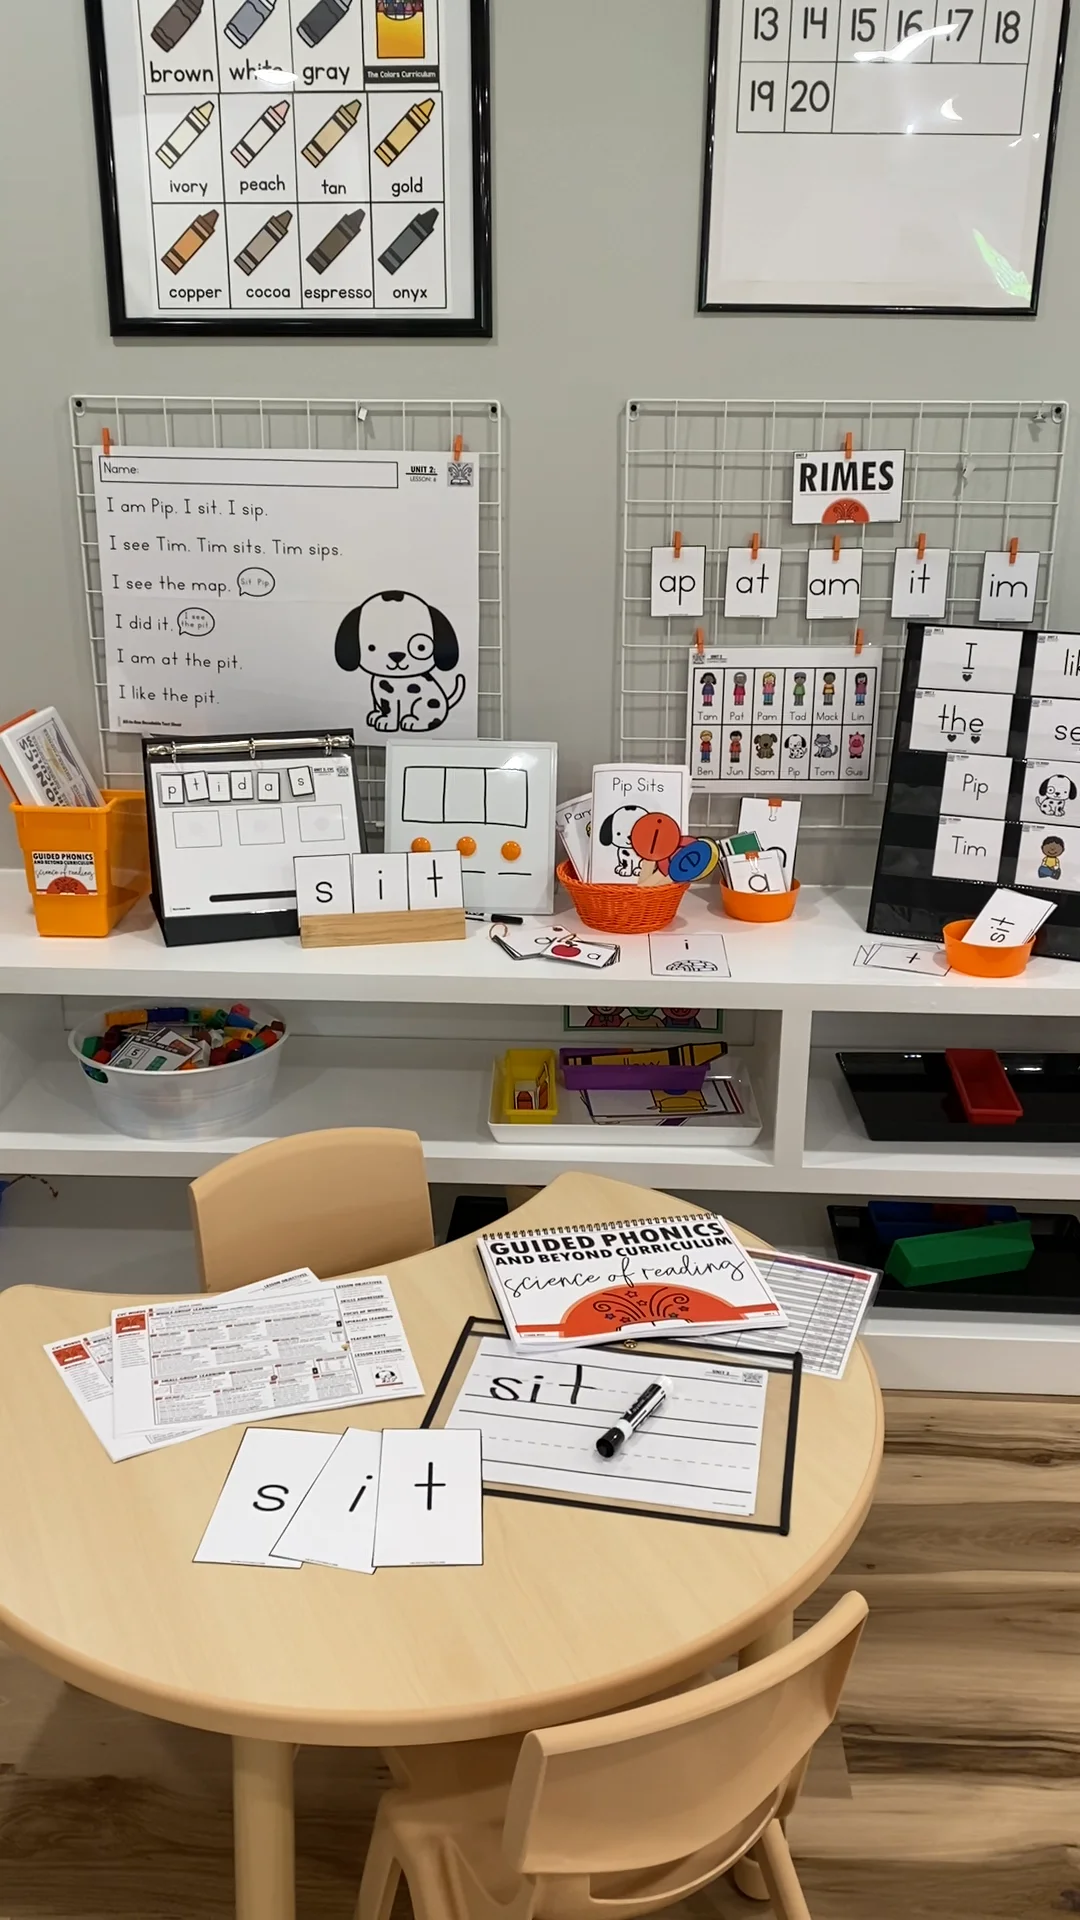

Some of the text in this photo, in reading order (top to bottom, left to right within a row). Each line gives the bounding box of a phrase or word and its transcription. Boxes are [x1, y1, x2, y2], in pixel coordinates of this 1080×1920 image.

[754, 6, 778, 42] 13
[802, 6, 828, 40] 14
[851, 8, 877, 42] 15
[946, 9, 974, 42] 17
[994, 10, 1020, 44] 18
[150, 61, 214, 83] brown
[302, 65, 350, 86] gray
[750, 80, 774, 112] 19
[790, 80, 830, 112] 20
[169, 180, 208, 196] ivory
[240, 174, 286, 193] peach
[320, 179, 347, 194] tan
[390, 177, 423, 196] gold
[169, 286, 222, 302] copper
[246, 286, 290, 298] cocoa
[304, 286, 372, 301] espresso
[392, 286, 428, 302] onyx
[104, 462, 140, 474] Name:
[800, 460, 894, 492] RIMES
[107, 496, 268, 521] I am Pip. I sit. I sip.
[110, 535, 342, 560] I see Tim. Tim sits. Tim sips.
[112, 574, 231, 597] I see the map.
[736, 564, 770, 594] at
[809, 576, 860, 596] am
[909, 564, 930, 594] it
[989, 574, 1028, 598] im
[659, 574, 696, 606] ap
[116, 614, 173, 632] I did it.
[117, 648, 242, 674] I am at the pit.
[962, 642, 978, 670] I
[119, 684, 220, 708] I like the pit.
[698, 712, 718, 721] Tam
[730, 712, 744, 721] Pat
[757, 712, 778, 721] Pam
[790, 712, 806, 721] Tad
[816, 712, 838, 721] Mack
[852, 712, 864, 721] Lin
[938, 704, 984, 732] the
[697, 767, 714, 776] Ben
[726, 767, 744, 776] Jun
[754, 767, 775, 776] Sam
[788, 767, 800, 778] Pip
[814, 767, 834, 776] Tom
[846, 767, 863, 776] Gus
[168, 776, 304, 800] p t i d a s
[612, 778, 665, 797] Pip Sits
[963, 773, 988, 800] Pip
[650, 818, 663, 854] i
[952, 836, 986, 857] Tim
[679, 851, 700, 872] e
[316, 860, 443, 904] s i t
[748, 874, 771, 892] a
[990, 916, 1016, 943] sit
[684, 939, 690, 950] i
[131, 1048, 140, 1056] 5
[490, 1222, 724, 1255] GUIDED PHONICS
[496, 1236, 732, 1266] AND BEYOND CURRICULUM
[504, 1254, 746, 1298] science of reading
[489, 1364, 598, 1404] sit
[252, 1462, 446, 1512] s i t
